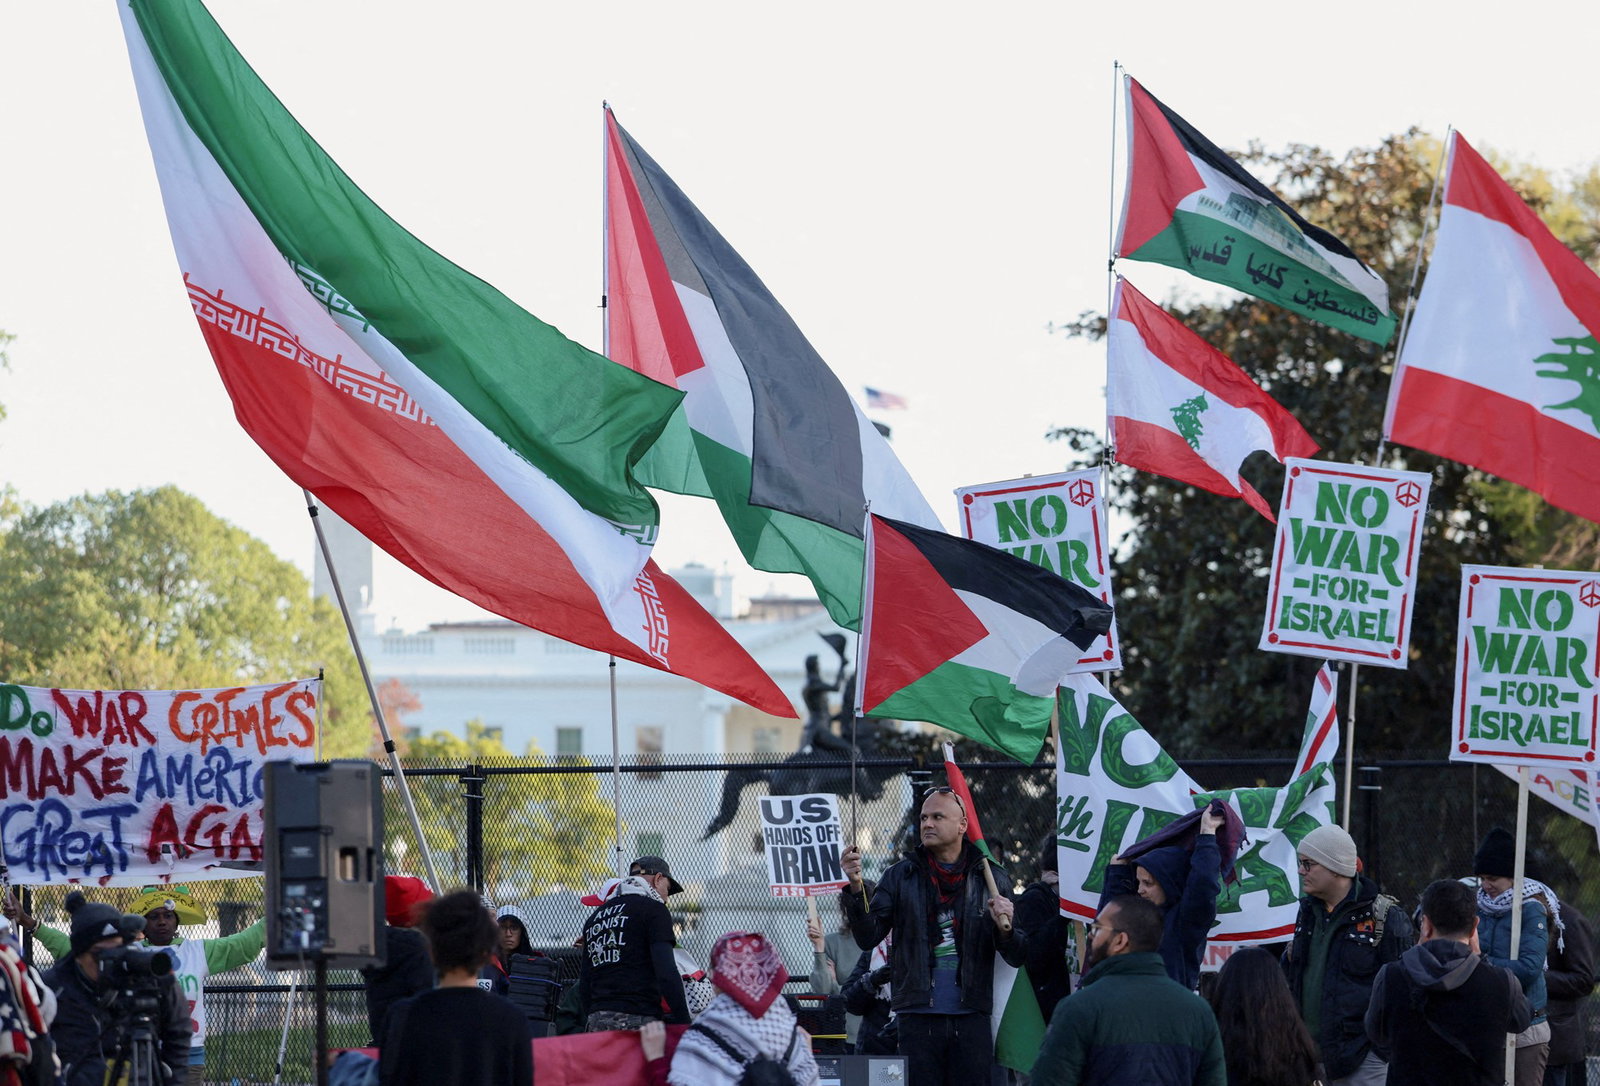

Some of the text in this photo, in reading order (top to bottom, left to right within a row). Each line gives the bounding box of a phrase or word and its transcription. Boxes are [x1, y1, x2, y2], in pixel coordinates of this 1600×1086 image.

[994, 494, 1068, 543] NO
[1314, 481, 1389, 528] NO
[1289, 517, 1404, 587] WAR
[1278, 595, 1395, 644] ISRAEL
[1497, 587, 1574, 631] NO
[1472, 625, 1594, 689] WAR
[51, 688, 156, 747] WAR
[168, 681, 316, 756] CRIMES
[1468, 704, 1589, 747] ISRAEL
[0, 735, 131, 800] MAKE
[761, 797, 838, 825] U.S.
[764, 824, 841, 846] HANDS OFF
[771, 843, 843, 884] IRAN
[585, 913, 629, 942] ZIONIST
[594, 903, 626, 922] ANTI
[587, 931, 626, 958] SOCIAL
[591, 948, 621, 967] CLUB
